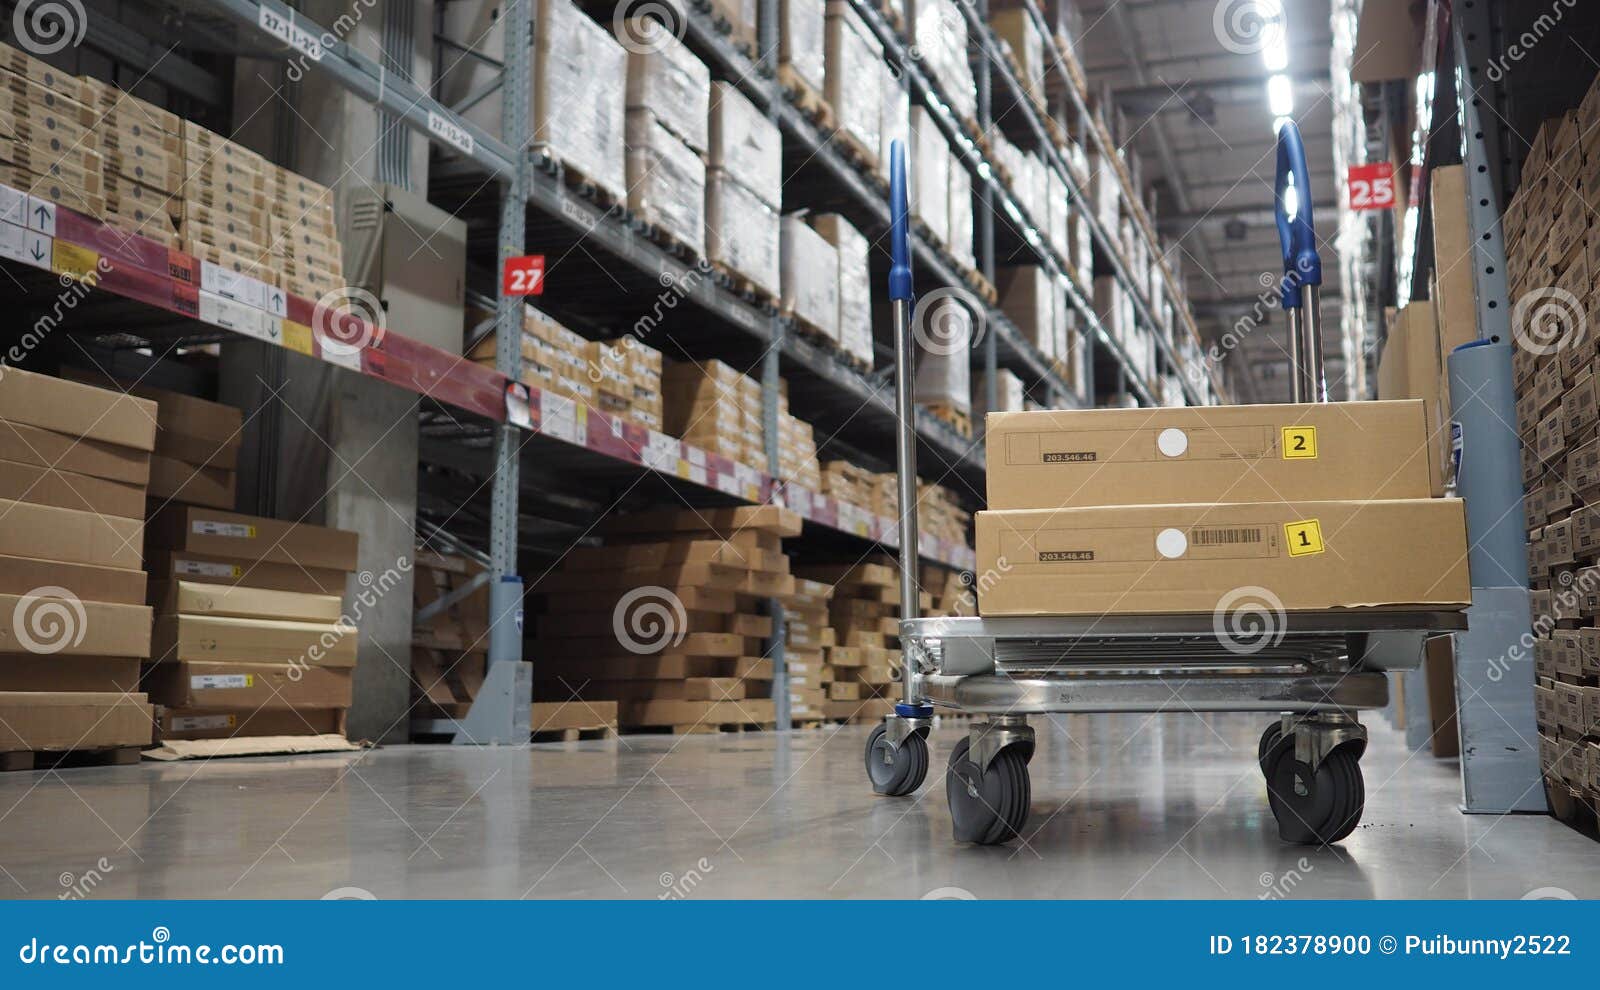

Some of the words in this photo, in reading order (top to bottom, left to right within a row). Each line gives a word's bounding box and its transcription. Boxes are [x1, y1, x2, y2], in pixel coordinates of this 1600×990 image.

[1351, 178, 1392, 206] 25
[511, 269, 542, 291] 27
[1293, 435, 1306, 450] 2
[1046, 454, 1094, 462] 203.546.46
[1298, 530, 1311, 546] 1
[1042, 552, 1092, 561] 203.546.46
